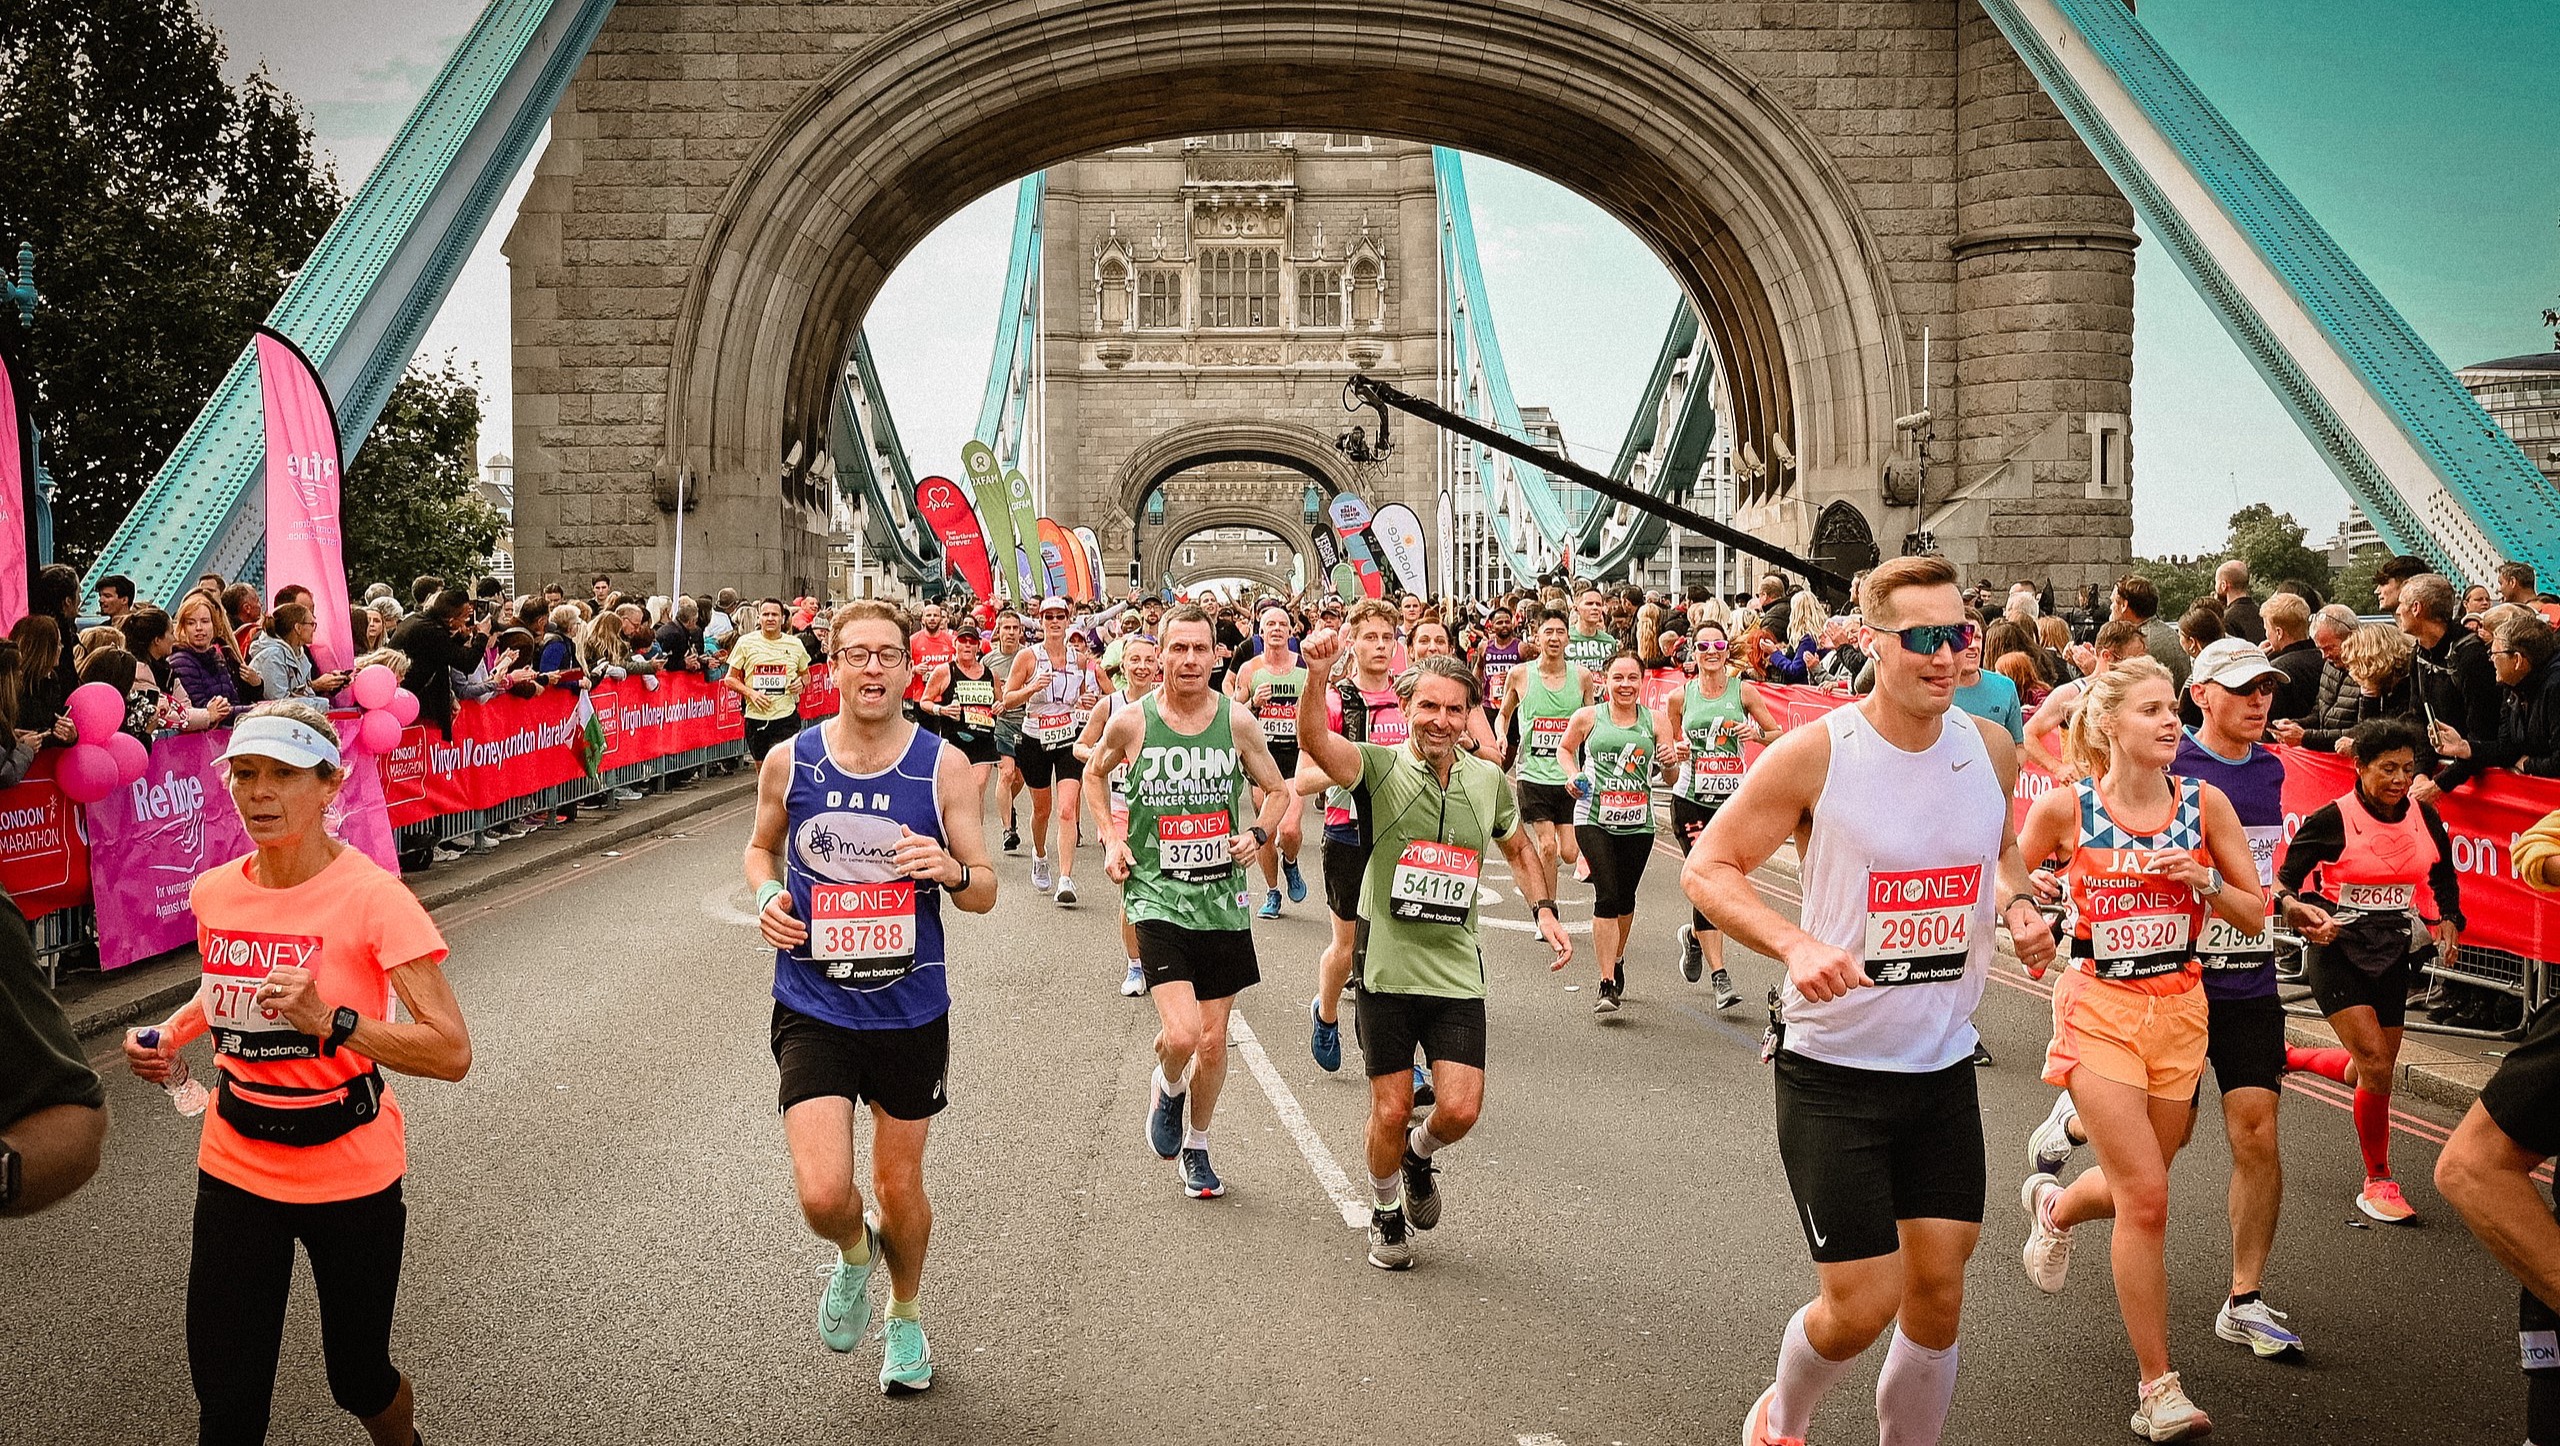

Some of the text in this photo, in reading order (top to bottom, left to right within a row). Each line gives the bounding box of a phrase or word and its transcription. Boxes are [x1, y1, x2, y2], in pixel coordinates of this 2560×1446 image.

[1320, 532, 1337, 565] VERSUS
[1565, 641, 1612, 658] CHRIS
[960, 694, 993, 703] TRACEY
[1271, 684, 1296, 694] IMON
[621, 704, 640, 736] Virgin
[642, 702, 665, 730] Money
[665, 699, 687, 723] London
[687, 696, 715, 720] Marathon
[1045, 727, 1072, 741] 55793
[1263, 721, 1294, 733] 46152
[1537, 734, 1563, 745] 1977
[390, 761, 424, 777] MARATHON
[430, 741, 461, 781] Virgin
[463, 738, 503, 770] Money
[1142, 746, 1236, 780] JOHN
[1602, 777, 1645, 791] JENNY
[1702, 777, 1739, 791] 27636
[827, 791, 890, 811] DAN
[1142, 792, 1229, 807] CANCER SUPPOR
[0, 806, 44, 830] ONDON
[1162, 815, 1225, 835] MONEY
[1605, 809, 1642, 822] 26498
[0, 827, 60, 855] MARATHON
[1169, 840, 1221, 863] 37301
[1400, 845, 1475, 870] MONEY
[1403, 873, 1466, 901] 54118
[1875, 868, 1978, 903] MONEY
[2082, 875, 2144, 888] Muscular
[817, 888, 909, 912] MONEY
[2095, 892, 2185, 915] MONEY
[2350, 886, 2405, 905] 52648
[1421, 912, 1462, 923] new balance
[825, 923, 903, 953] 38788
[1880, 913, 1966, 949] 29604
[2106, 921, 2177, 952] 39320
[207, 934, 316, 968] MONEY
[854, 965, 906, 978] new balance
[1910, 971, 1930, 980] new
[2135, 962, 2177, 976] new balance
[260, 1045, 309, 1057] balance
